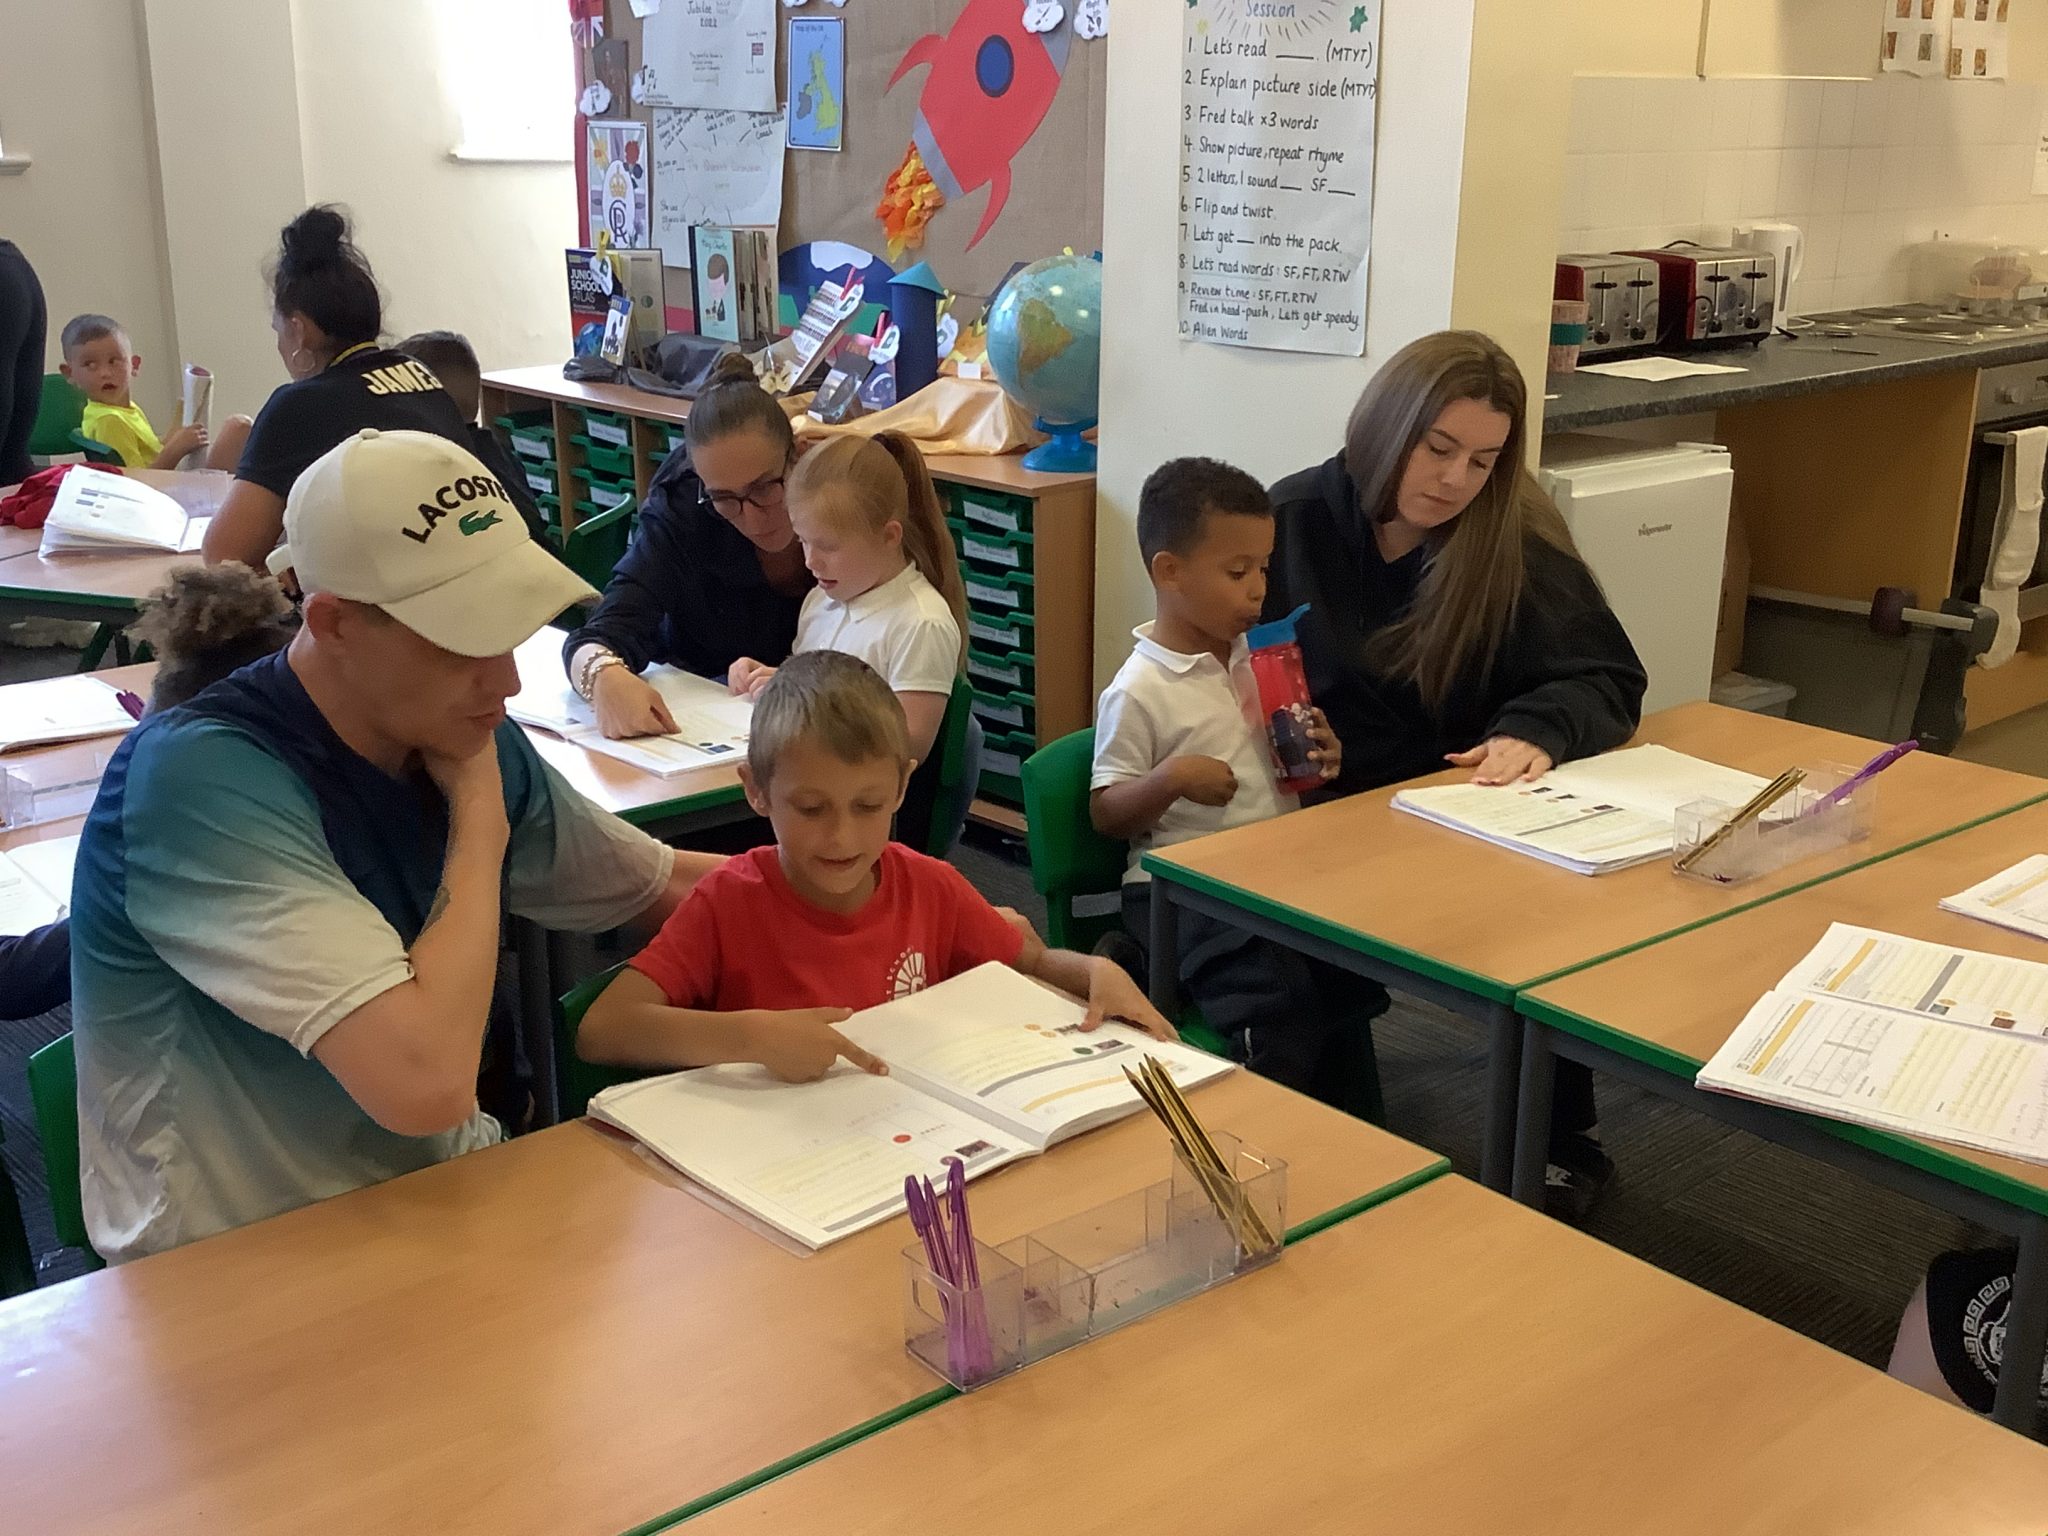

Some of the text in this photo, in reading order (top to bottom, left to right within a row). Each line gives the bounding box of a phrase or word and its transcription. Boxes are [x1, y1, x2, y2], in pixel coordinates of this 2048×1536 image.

[1245, 0, 1295, 18] Session
[1204, 35, 1232, 55] Let's
[1237, 38, 1267, 57] read
[1326, 38, 1373, 69] (MTYT)
[1200, 68, 1247, 98] Explain
[1252, 73, 1301, 101] picture
[1308, 79, 1337, 97] side
[1200, 105, 1226, 124] Fred
[1231, 108, 1254, 126] talk
[1280, 114, 1319, 130] words
[1200, 135, 1225, 155] Show
[1308, 147, 1344, 173] rhyme
[1198, 167, 1204, 183] 2
[1247, 175, 1278, 188] sound
[1310, 177, 1328, 192] SF
[1194, 197, 1218, 219] Flip
[1220, 203, 1239, 216] and
[1216, 229, 1235, 254] get
[1259, 232, 1281, 247] into
[1285, 233, 1304, 249] the
[570, 268, 593, 281] JUNIO
[1218, 260, 1239, 273] read
[1190, 282, 1221, 297] Review
[1189, 300, 1209, 313] Fred
[1209, 306, 1219, 314] in
[1302, 310, 1323, 331] get
[1323, 309, 1359, 332] speedy
[1193, 321, 1217, 337] Alien
[1220, 325, 1249, 341] Words
